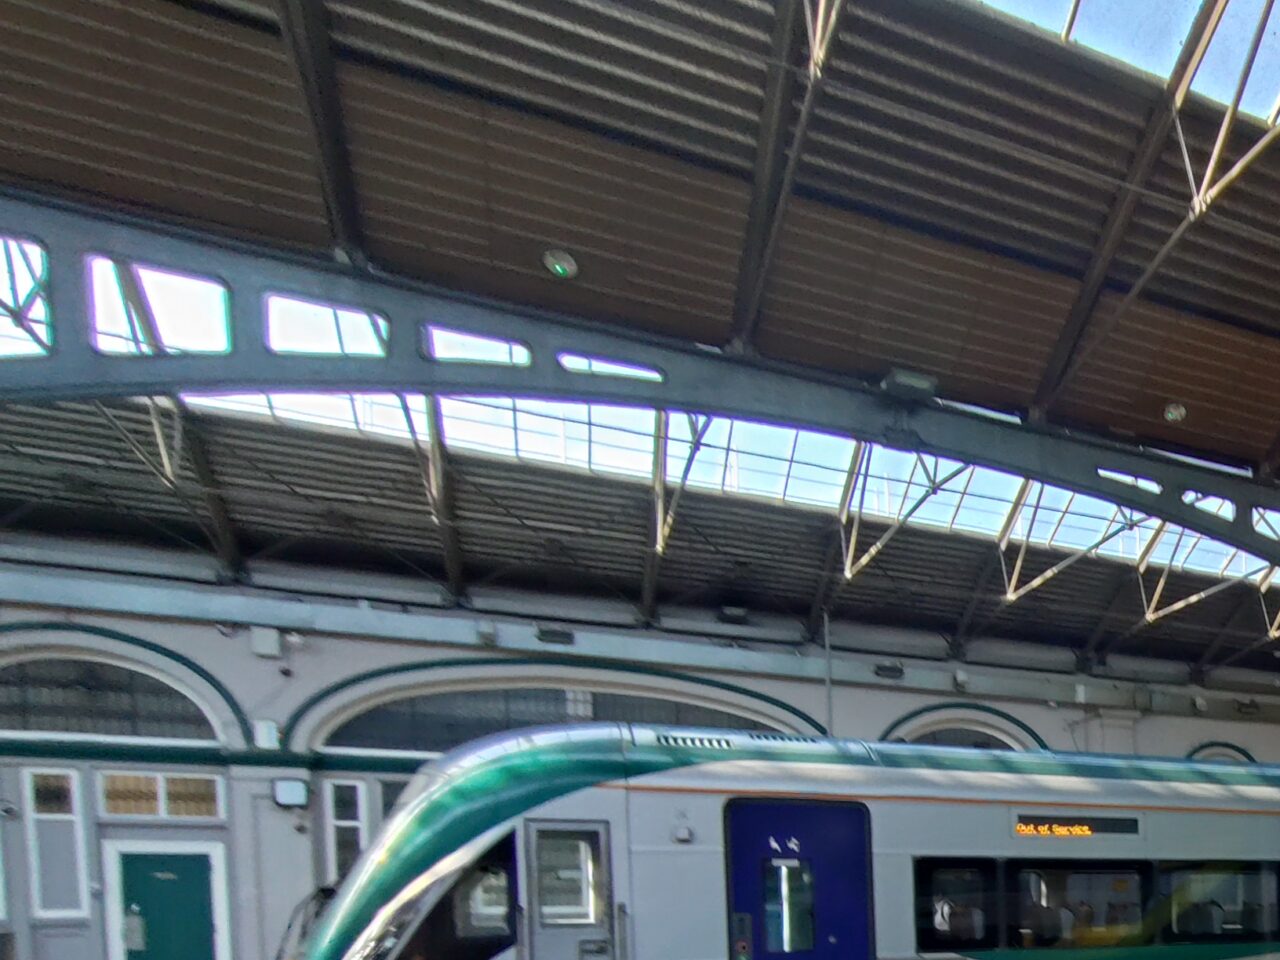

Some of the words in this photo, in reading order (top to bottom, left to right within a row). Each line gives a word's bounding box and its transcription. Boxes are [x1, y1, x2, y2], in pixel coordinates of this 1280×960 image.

[1016, 823, 1037, 834] Out
[1038, 824, 1051, 834] of
[1052, 824, 1093, 836] Service
